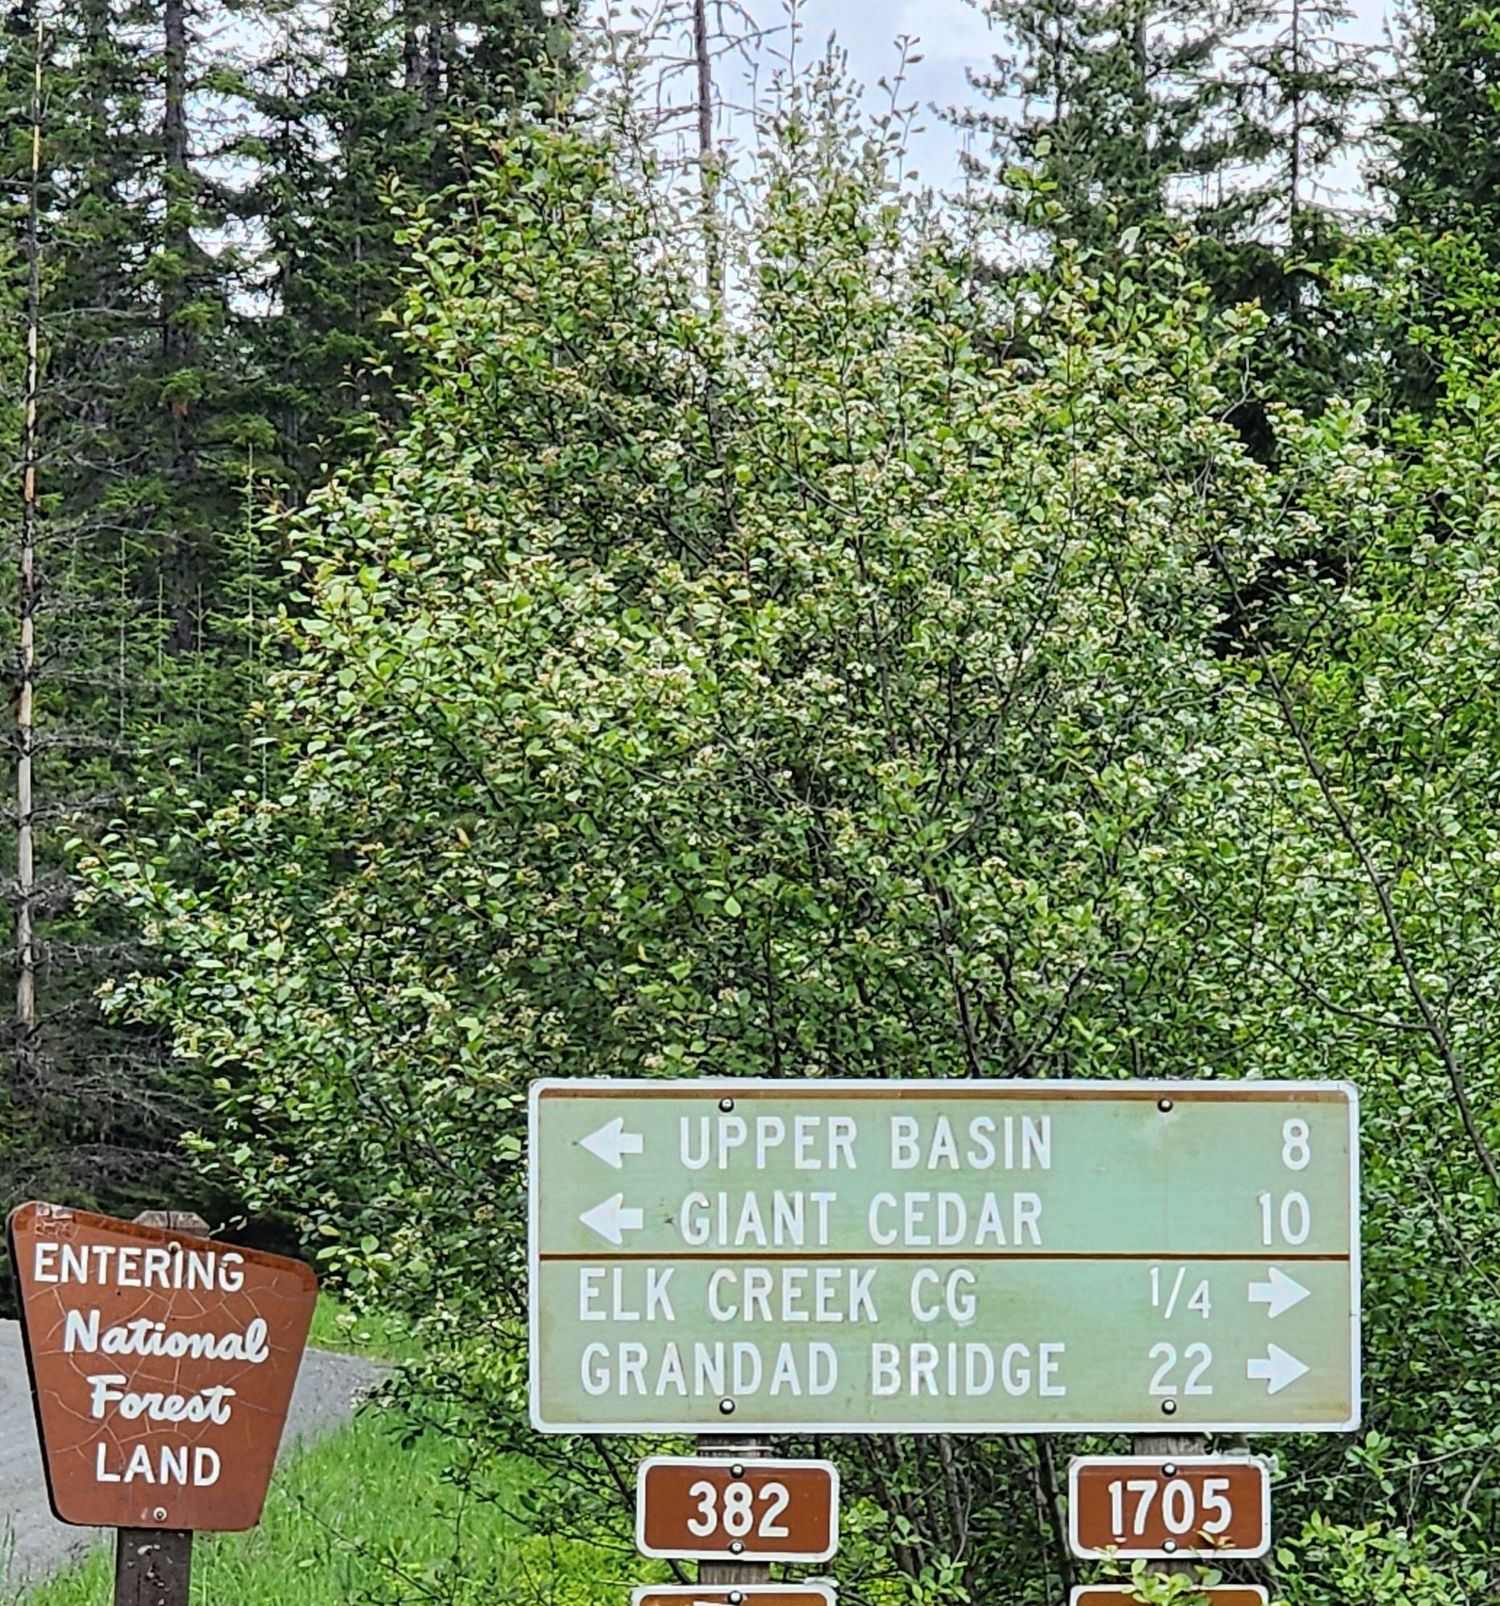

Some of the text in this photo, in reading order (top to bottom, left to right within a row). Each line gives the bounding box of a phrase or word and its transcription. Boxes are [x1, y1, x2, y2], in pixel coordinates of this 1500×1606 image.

[680, 1115, 1312, 1170] UPPER BASIN 8
[680, 1192, 1312, 1246] GIANT CEDAR 10
[33, 1243, 245, 1292] ENTERING
[579, 1266, 1213, 1322] ELK CREEK CG 1/4
[64, 1309, 269, 1363] National
[580, 1343, 1213, 1397] GRANDAD BRIDGE 22
[86, 1374, 236, 1425] Forest
[96, 1442, 221, 1486] LAND
[687, 1481, 790, 1538] 382
[1108, 1478, 1233, 1536] 1705
